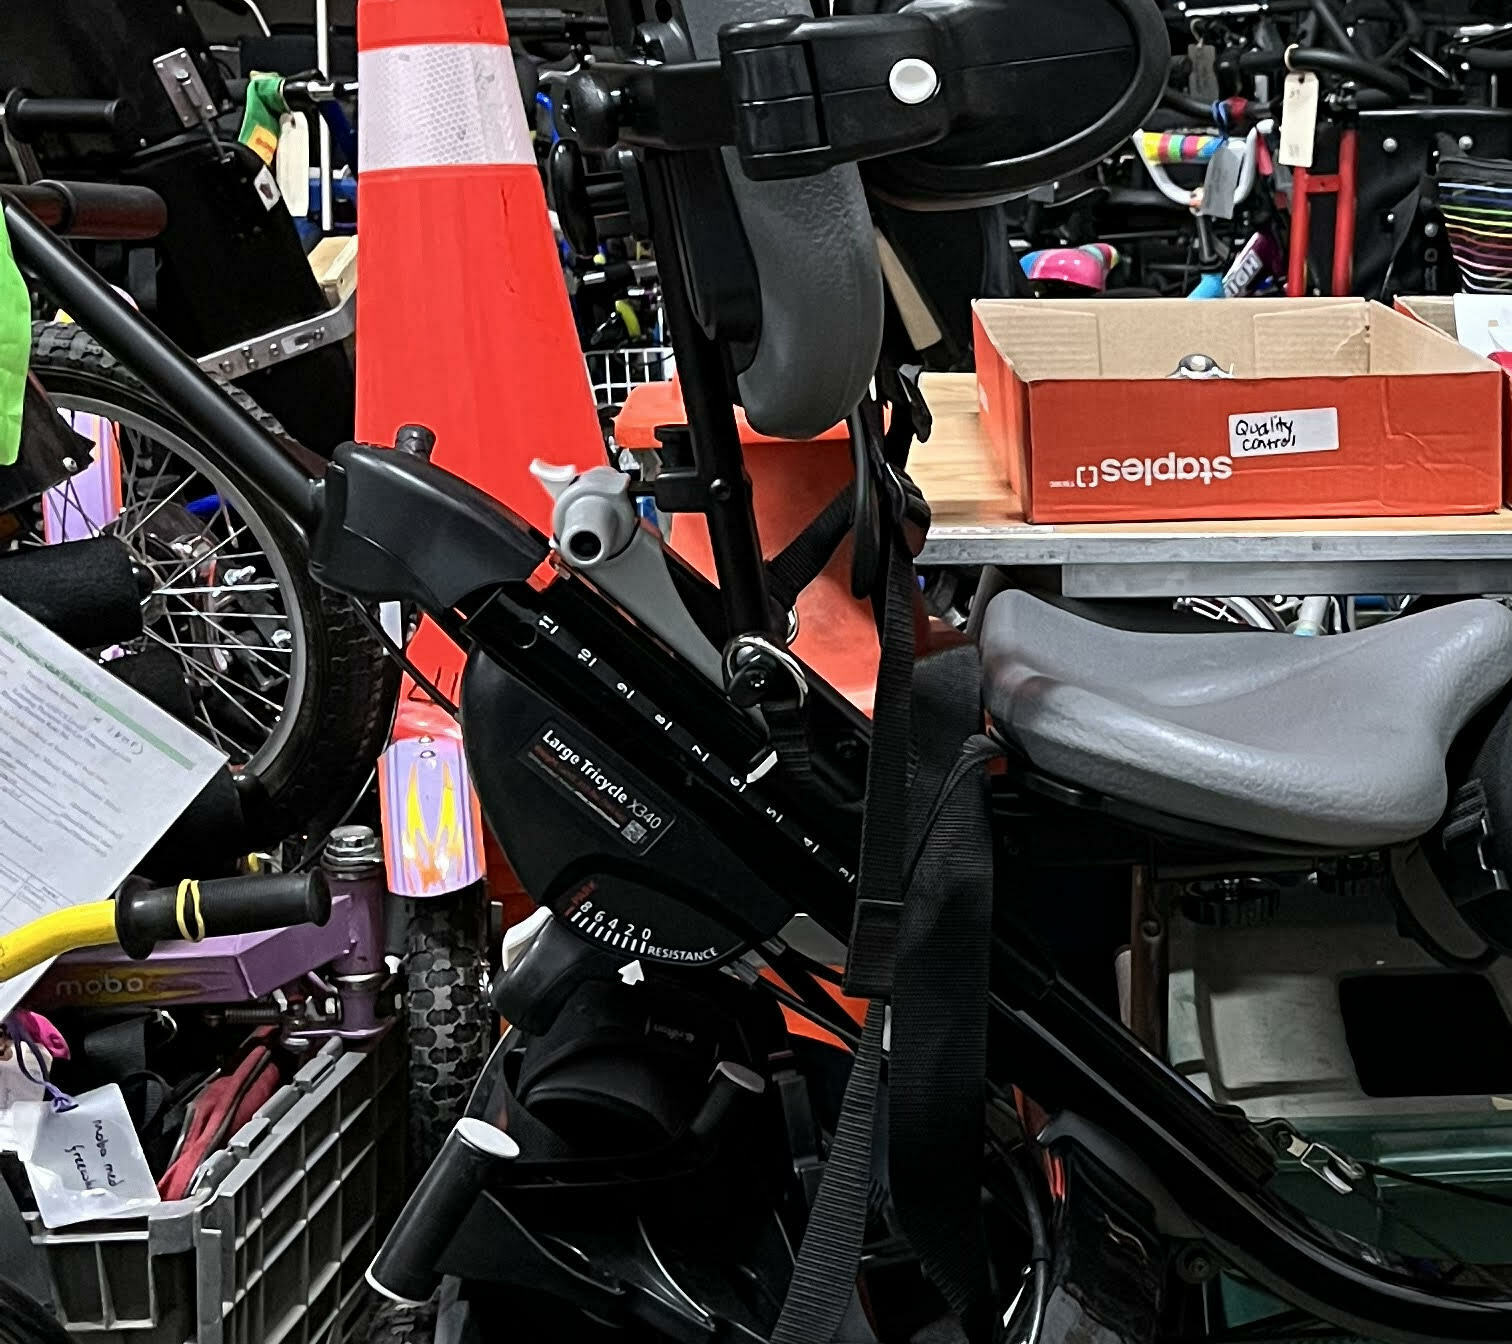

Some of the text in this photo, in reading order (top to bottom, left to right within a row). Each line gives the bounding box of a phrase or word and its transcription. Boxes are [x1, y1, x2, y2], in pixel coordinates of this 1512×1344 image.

[1235, 414, 1294, 438] Quality
[1100, 452, 1233, 486] staples
[542, 729, 580, 765] Large
[580, 758, 628, 804] Tricycle
[626, 798, 662, 829] X340
[580, 900, 652, 941] 8 6 4 2 0
[647, 945, 719, 962] RESISTANCE
[56, 973, 144, 995] mobo
